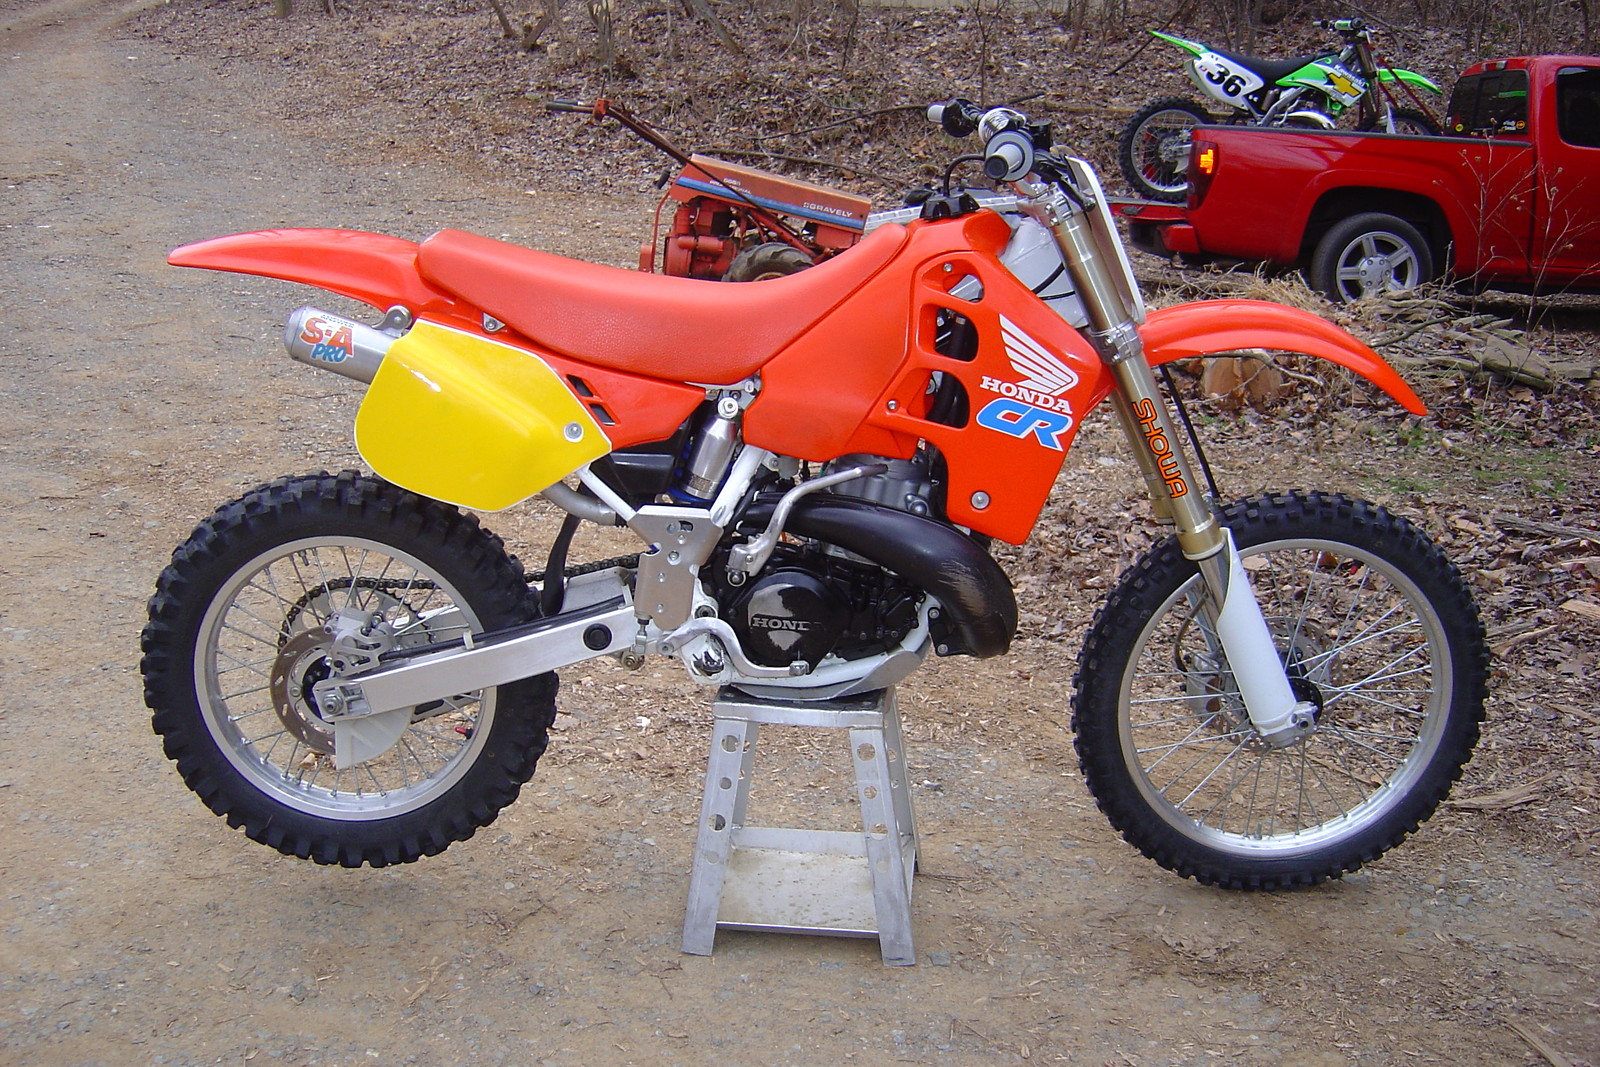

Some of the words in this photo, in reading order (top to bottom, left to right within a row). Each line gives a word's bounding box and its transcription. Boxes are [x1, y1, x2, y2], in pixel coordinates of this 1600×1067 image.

[1205, 63, 1247, 98] 36
[809, 203, 853, 218] GRAVELY
[311, 343, 347, 363] PRO
[979, 375, 1073, 415] HONDA
[976, 397, 1073, 452] CR
[1132, 398, 1188, 498] SHOWA
